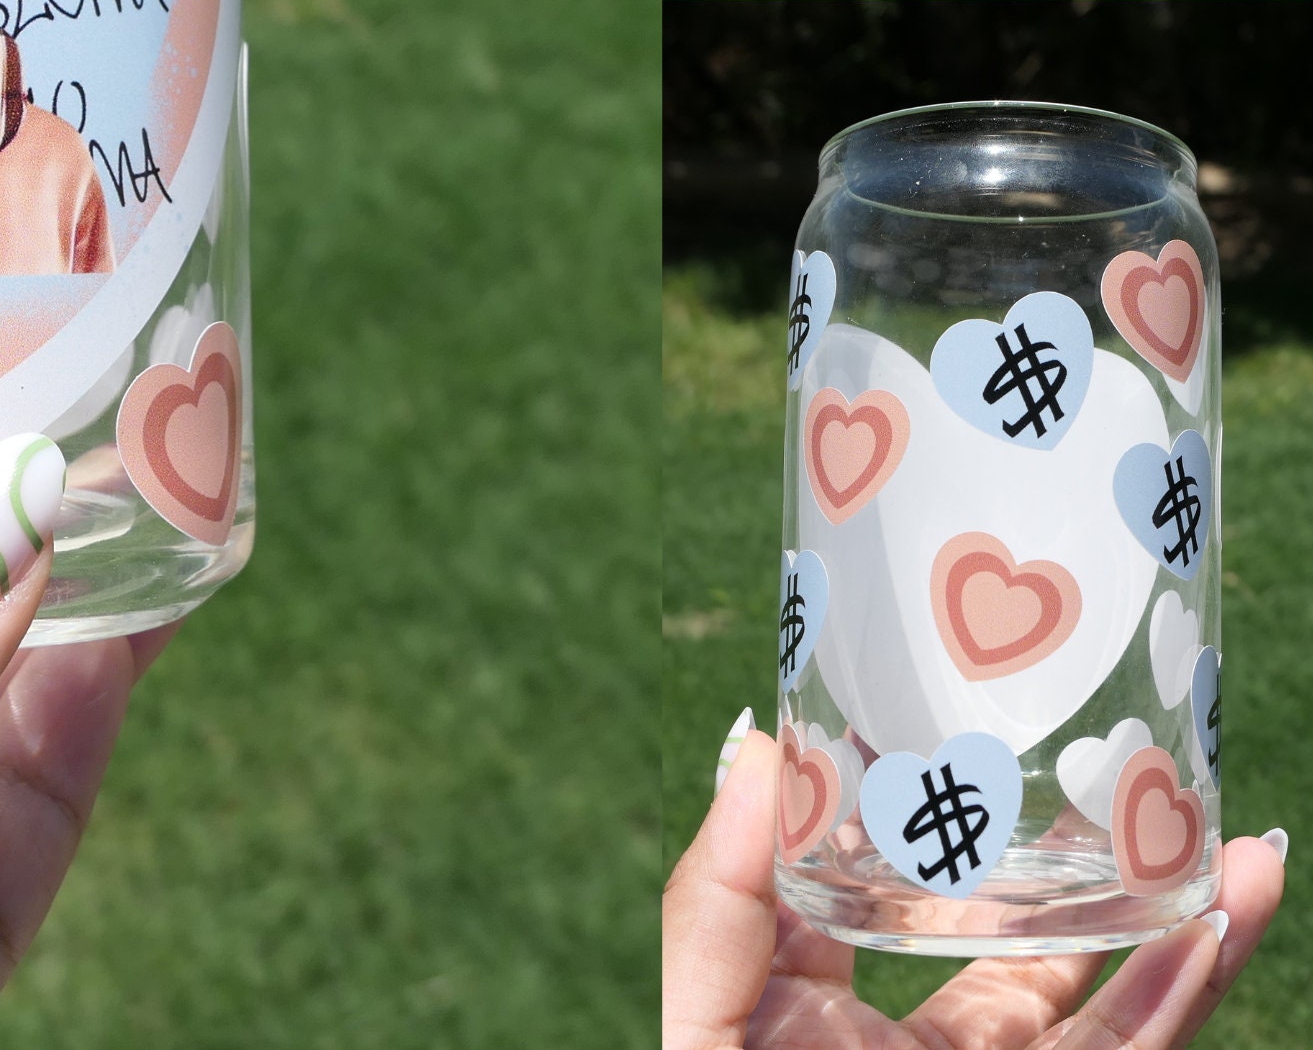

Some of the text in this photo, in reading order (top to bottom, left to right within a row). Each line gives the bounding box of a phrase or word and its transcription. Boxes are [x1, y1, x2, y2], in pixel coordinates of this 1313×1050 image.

[982, 322, 1068, 439] $
[1151, 455, 1202, 568] $
[902, 762, 990, 886] $
